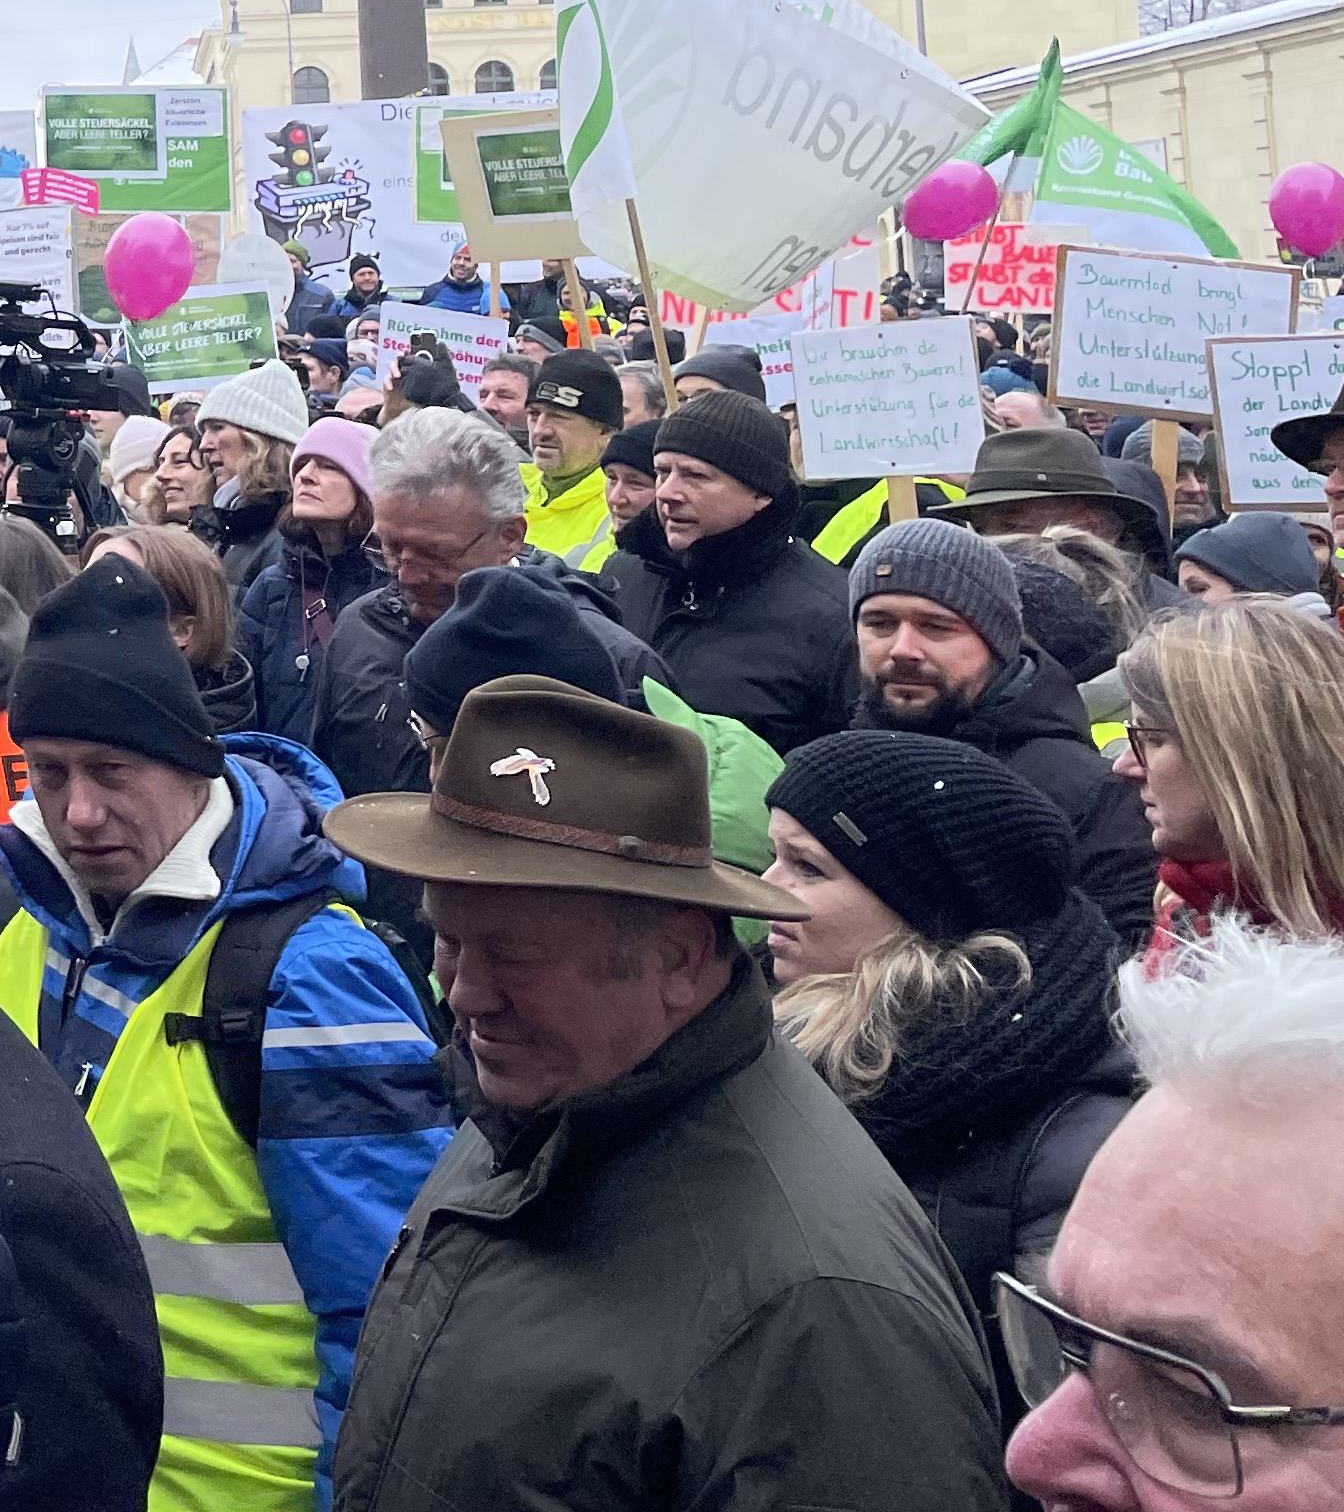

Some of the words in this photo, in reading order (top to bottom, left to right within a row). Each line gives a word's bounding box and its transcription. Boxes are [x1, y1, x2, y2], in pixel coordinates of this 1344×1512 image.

[49, 118, 77, 129] VOLLE
[54, 130, 78, 140] ABER
[79, 129, 109, 139] LEERE
[167, 139, 199, 152] SAM
[485, 160, 515, 172] VOLLE
[493, 171, 518, 183] ABER
[1087, 297, 1176, 328] Menschen
[138, 324, 168, 341] VOLLE
[174, 334, 210, 351] LEERE
[476, 334, 501, 348] der
[1231, 349, 1311, 392] Stoppt
[1077, 371, 1100, 389] die
[1243, 396, 1265, 413] der
[1252, 477, 1281, 489] aus
